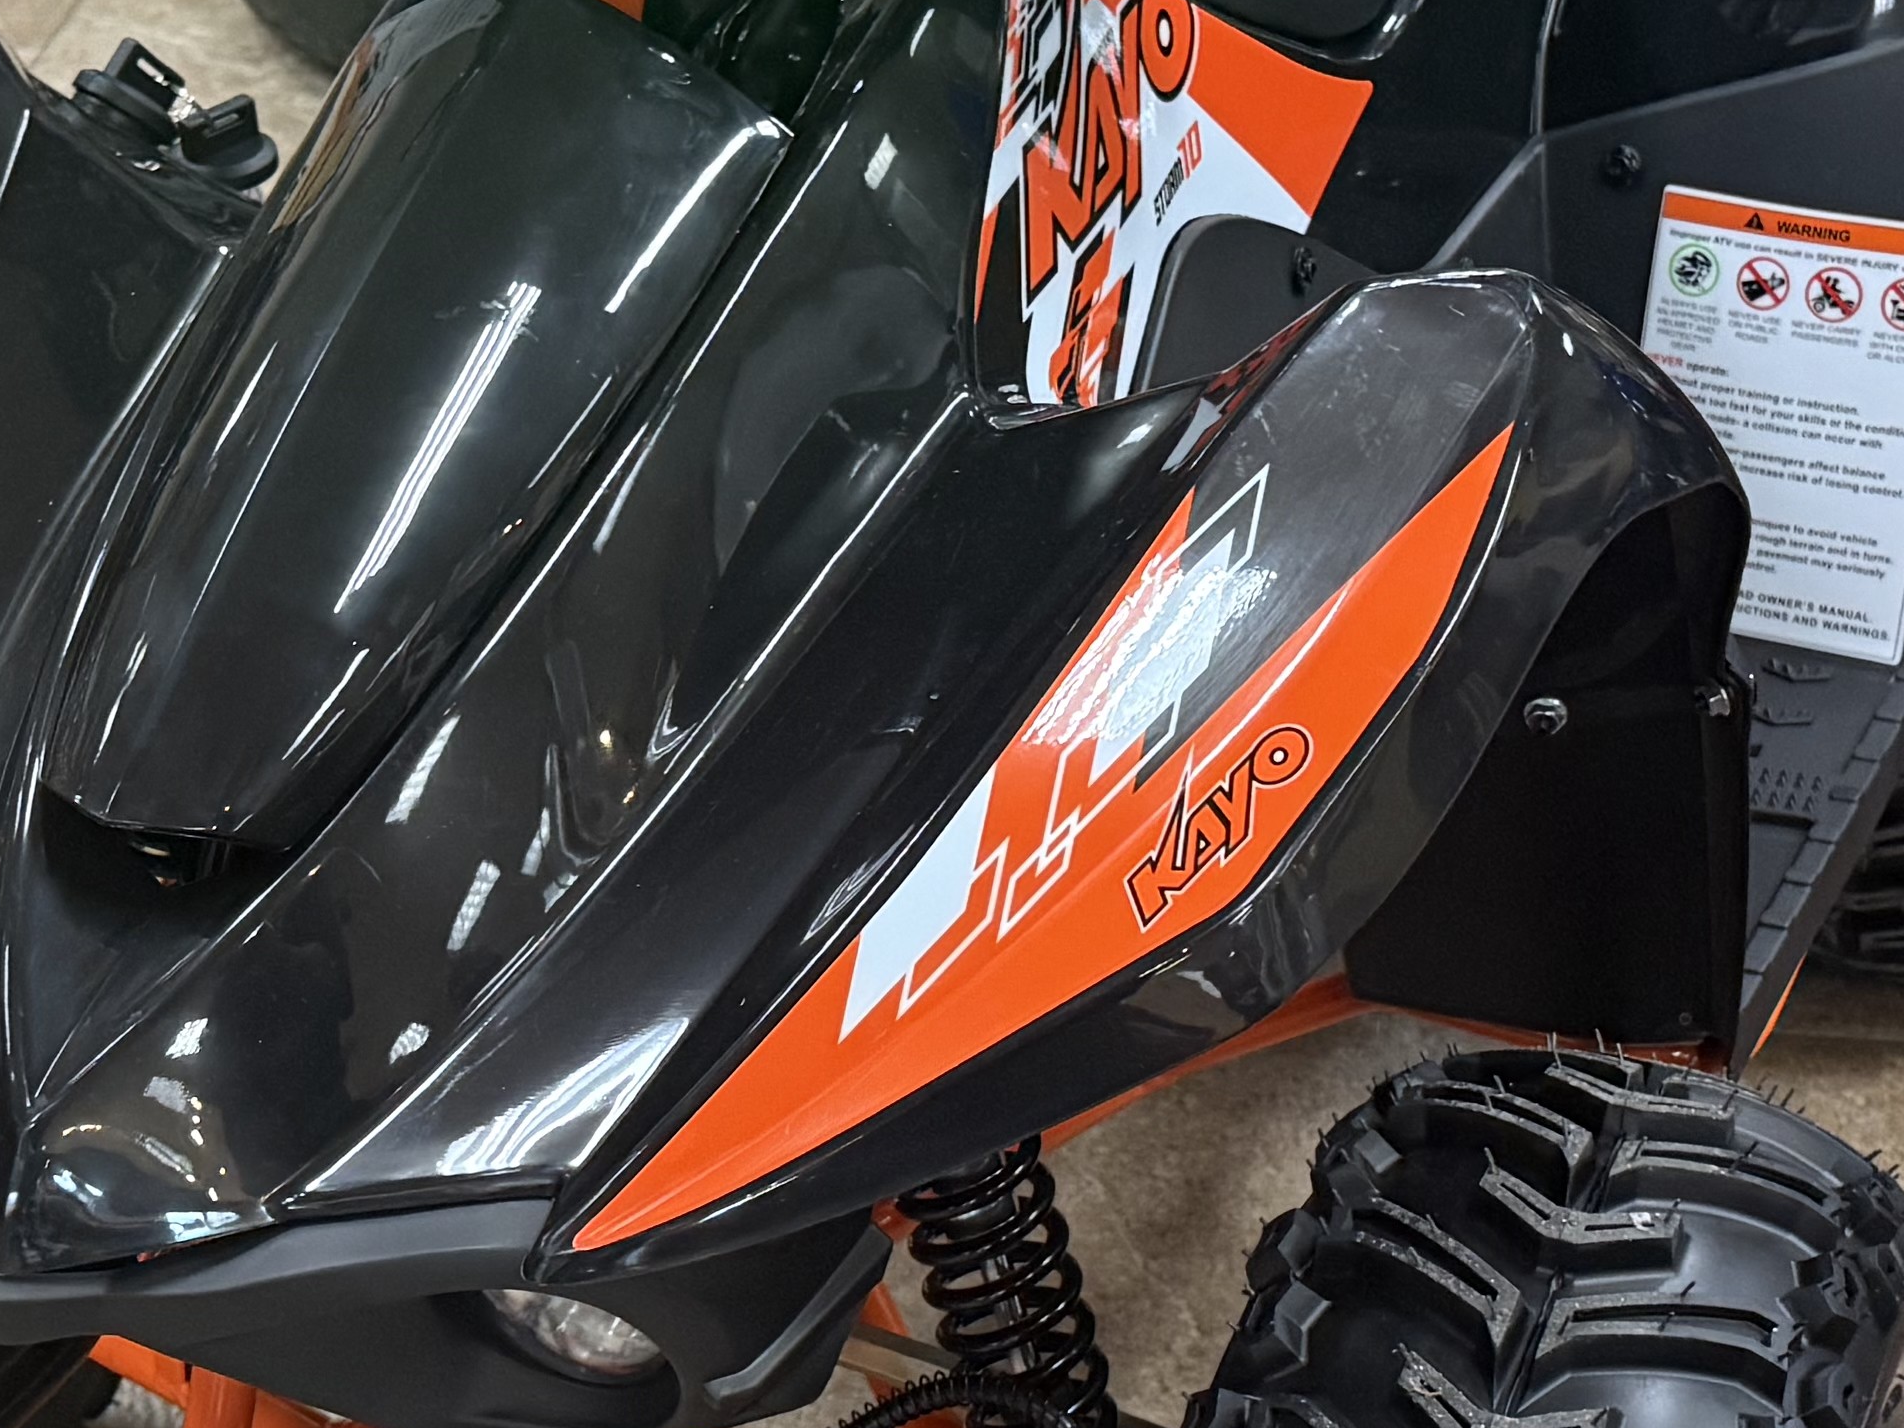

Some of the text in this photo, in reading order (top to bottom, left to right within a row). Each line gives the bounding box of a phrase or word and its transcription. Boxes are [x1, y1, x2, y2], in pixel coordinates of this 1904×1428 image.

[1777, 220, 1851, 243] WARNING
[1712, 236, 1734, 247] ATV
[1753, 245, 1772, 253] can
[1773, 249, 1802, 259] result
[1803, 251, 1814, 259] in
[1816, 252, 1858, 267] SEVERE
[1861, 260, 1899, 272] INJURY
[1700, 382, 1735, 395] proper
[1738, 388, 1779, 405] training
[1782, 397, 1794, 405] or
[1709, 398, 1727, 408] too
[1729, 400, 1749, 412] fast
[1752, 405, 1767, 416] for
[1770, 410, 1794, 420] your
[1798, 414, 1827, 426] skills
[1829, 420, 1841, 428] or
[1844, 421, 1862, 432] the
[1751, 422, 1798, 437] collision
[1801, 429, 1822, 440] can
[1824, 434, 1856, 446] occur
[1859, 439, 1883, 450] with
[1739, 464, 1785, 480] increase
[1787, 472, 1808, 483] risk
[1810, 476, 1823, 486] of
[1825, 478, 1859, 494] losing
[1807, 460, 1840, 474] affect
[1842, 465, 1886, 481] balance
[1755, 533, 1787, 547] rough
[1789, 540, 1825, 553] terrain
[1827, 545, 1848, 557] and
[1850, 550, 1860, 559] in
[1793, 524, 1805, 535] to
[1806, 528, 1837, 542] avoid
[1840, 533, 1878, 548] vehicle
[1756, 549, 1885, 581] pavement may seriously
[1757, 592, 1815, 613] OWNER'S
[1791, 615, 1818, 628] AND
[1122, 722, 1314, 934] KAYO
